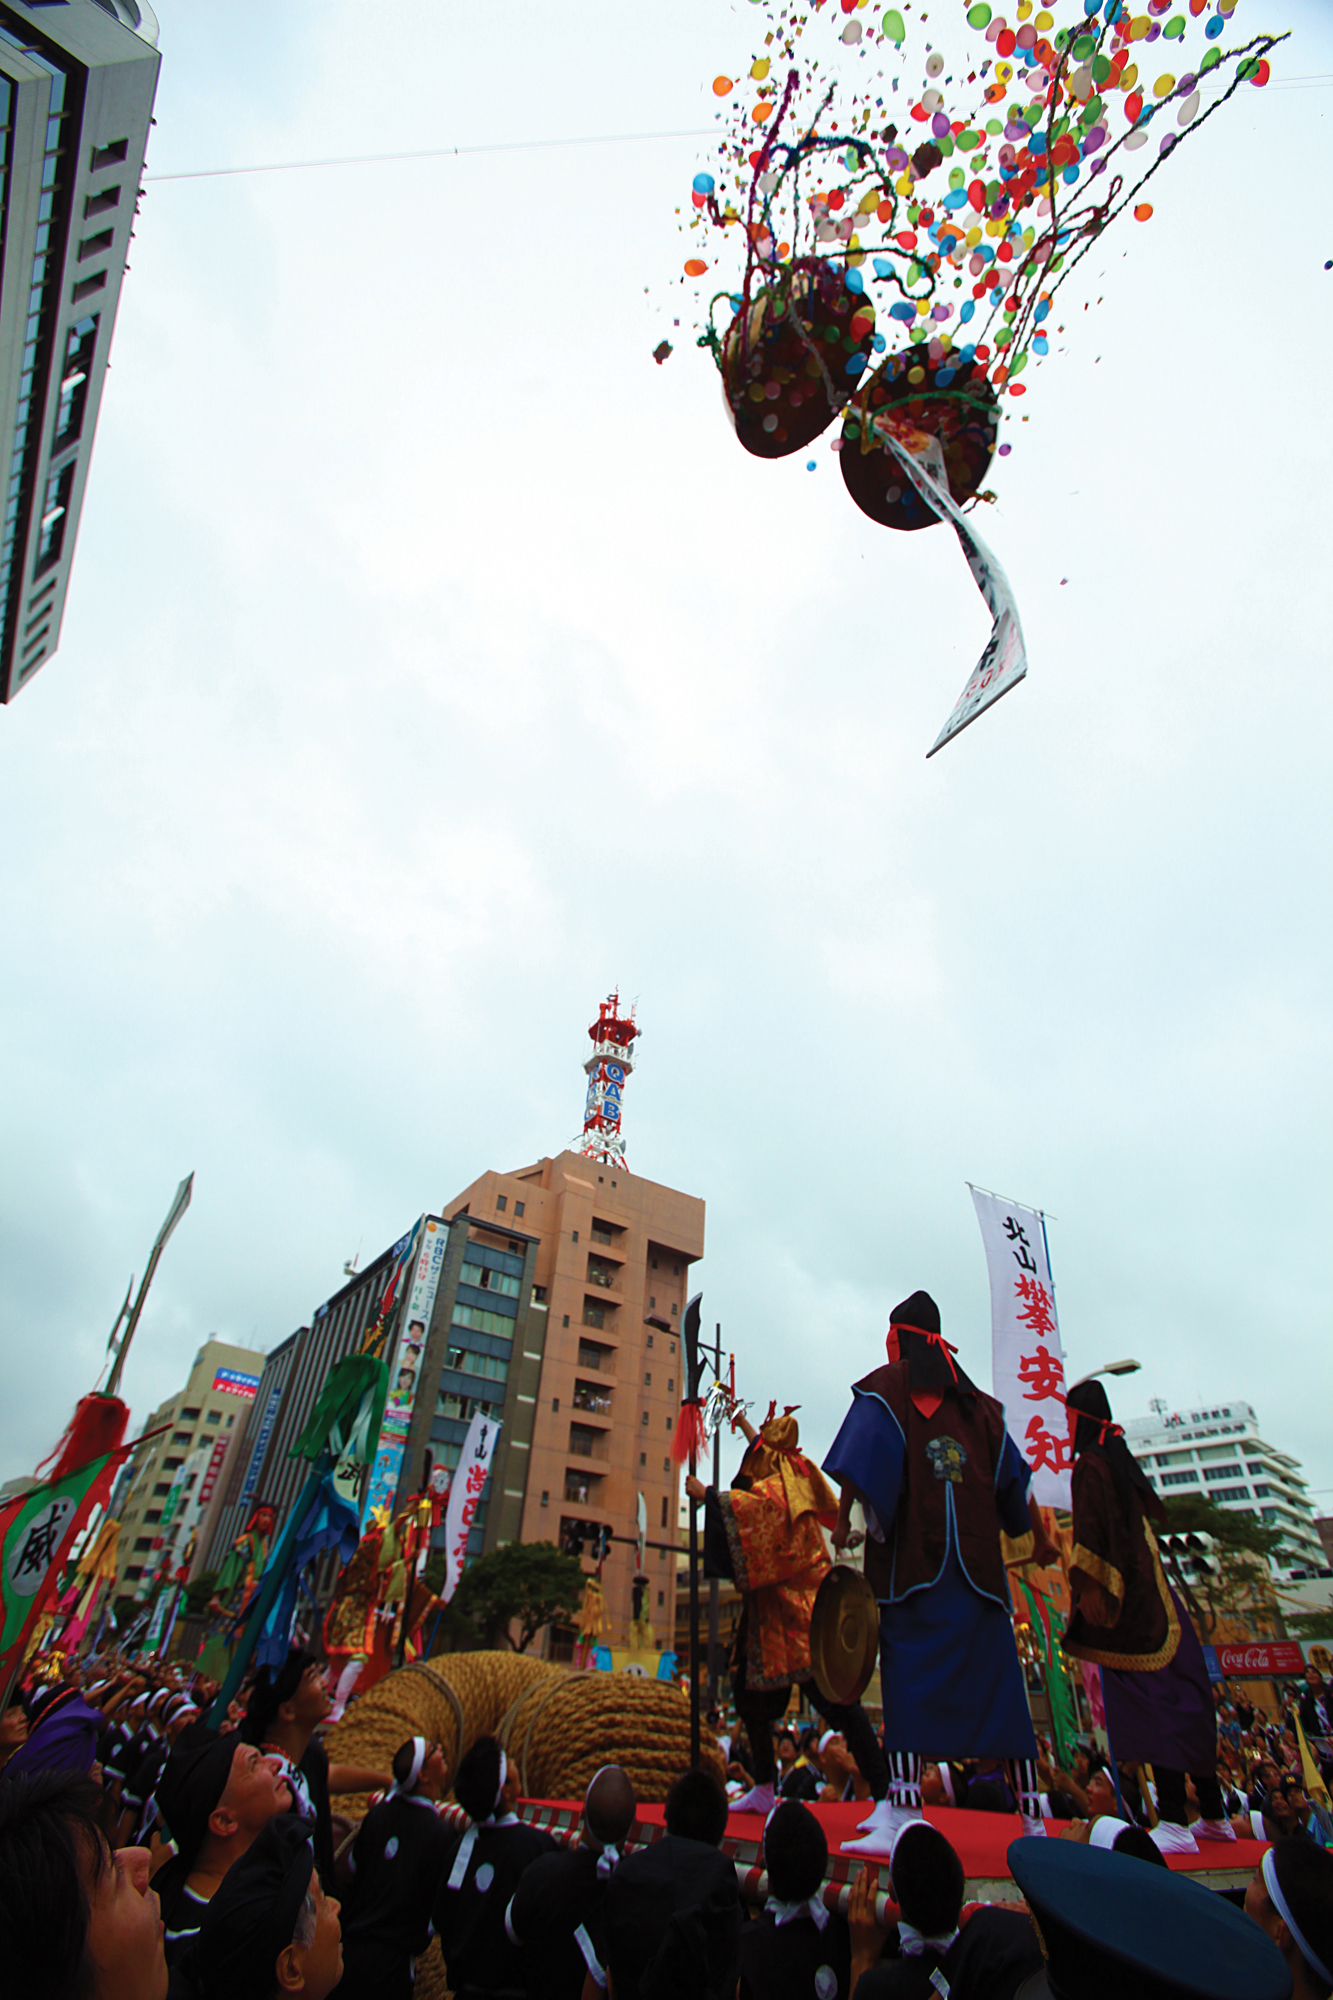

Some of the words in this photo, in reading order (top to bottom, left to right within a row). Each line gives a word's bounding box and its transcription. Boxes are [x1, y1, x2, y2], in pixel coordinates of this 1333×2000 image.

[604, 1063, 624, 1120] QAB
[1164, 1412, 1186, 1429] JAL
[1191, 1407, 1231, 1423] 日本航空
[11, 1503, 68, 1580] 威
